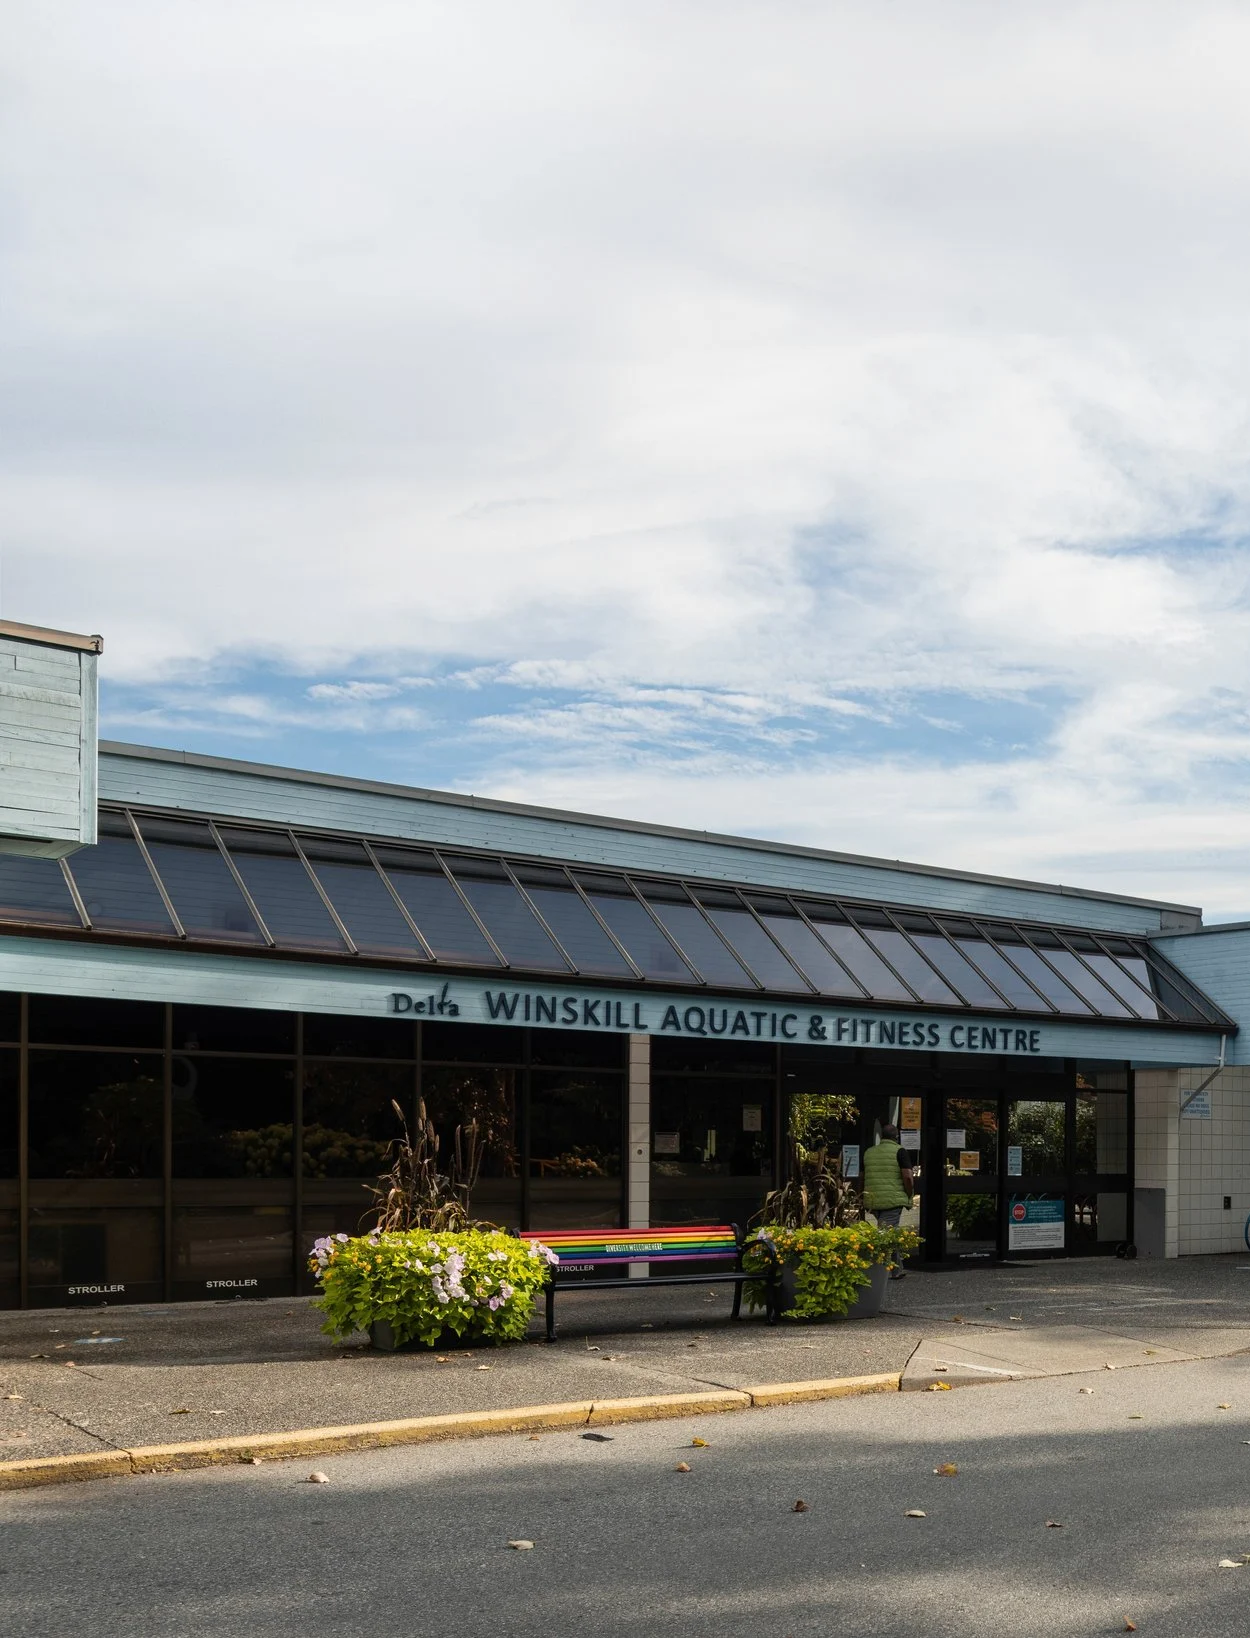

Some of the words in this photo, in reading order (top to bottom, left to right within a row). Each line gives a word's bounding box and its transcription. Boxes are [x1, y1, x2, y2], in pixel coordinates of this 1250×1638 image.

[391, 982, 460, 1017] Delta
[485, 990, 649, 1030] WINSKILL
[660, 1004, 798, 1039] AQUATIC
[807, 1014, 828, 1041] &
[836, 1017, 941, 1047] FITNESS
[950, 1025, 1042, 1053] CENTRE
[68, 1284, 126, 1294] STROLLER
[205, 1278, 258, 1289] STROLLER
